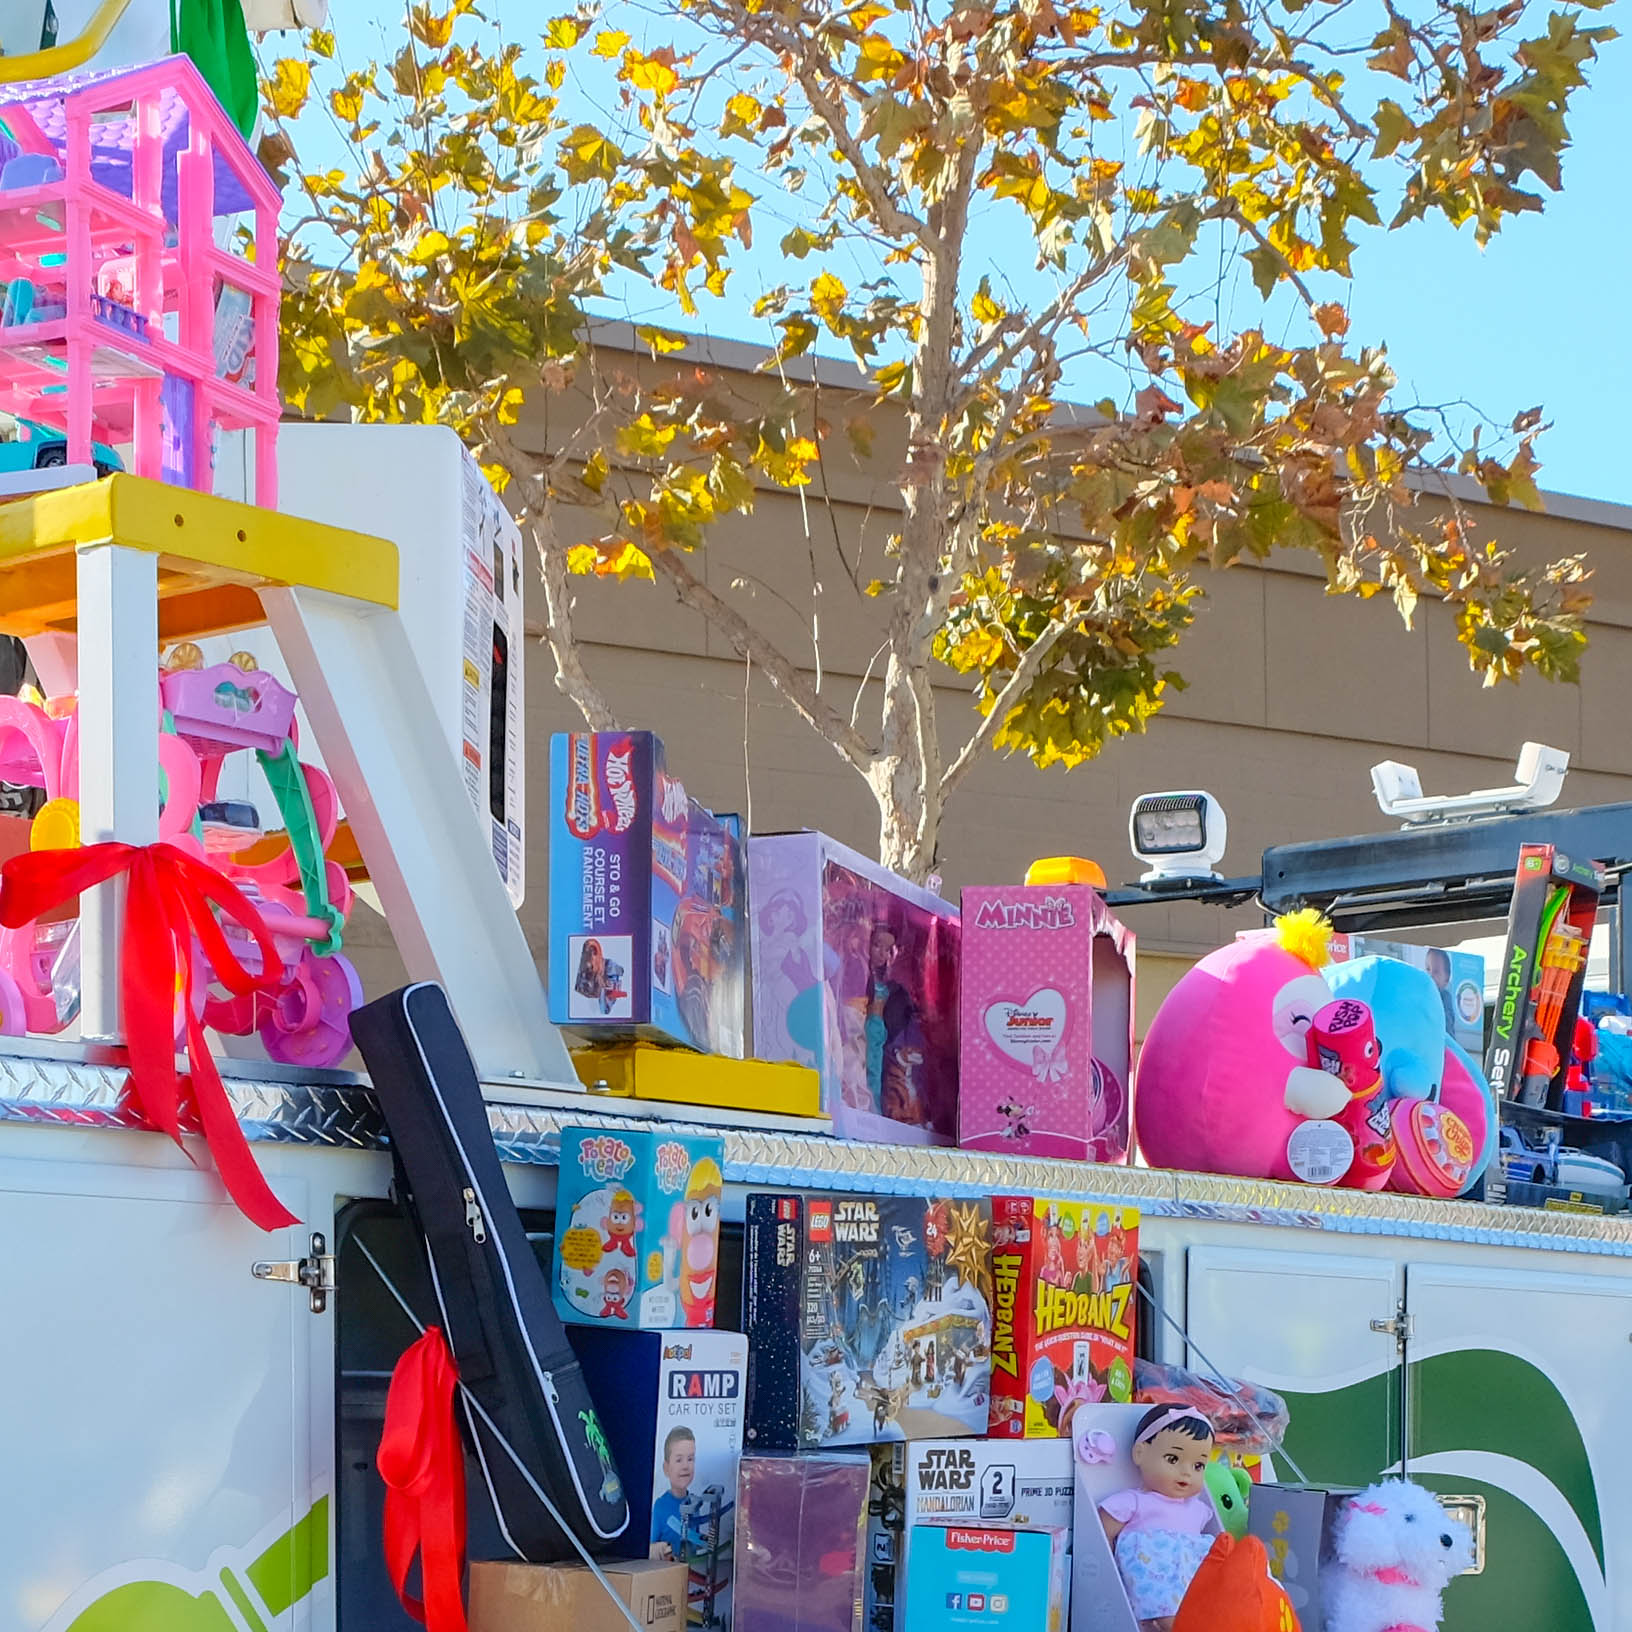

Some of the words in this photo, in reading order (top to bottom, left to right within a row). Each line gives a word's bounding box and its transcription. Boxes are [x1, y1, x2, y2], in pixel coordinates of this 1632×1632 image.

[594, 848, 605, 899] COURSE
[610, 853, 620, 880] STO
[583, 846, 593, 929] RANGEMENT
[610, 885, 620, 894] &
[594, 904, 604, 924] ET
[610, 897, 620, 917] GO
[976, 897, 1077, 929] MINNIE
[1496, 944, 1528, 1040] Archery
[1328, 1000, 1353, 1033] PUSH
[1343, 1004, 1365, 1029] POP
[1488, 1047, 1510, 1095] Set
[579, 1135, 632, 1163] Potato
[810, 1213, 830, 1230] LEGO
[834, 1201, 880, 1221] STAR
[834, 1222, 879, 1242] WARS
[926, 1222, 938, 1236] 24
[776, 1223, 788, 1267] WARS
[785, 1222, 796, 1267] STAR
[809, 1249, 821, 1264] 6+
[807, 1302, 817, 1313] 320
[992, 1253, 1022, 1379] HEDBANZ
[1034, 1278, 1133, 1341] HEDBANZ
[672, 1373, 734, 1397] RAMP
[669, 1404, 689, 1415] CAR
[694, 1403, 714, 1415] TOY
[718, 1402, 737, 1414] SET
[918, 1449, 975, 1469] STAR
[918, 1470, 975, 1490] WARS
[992, 1471, 1002, 1494] 2
[1021, 1487, 1042, 1497] PRIME
[917, 1496, 975, 1513] MANDALORIAN
